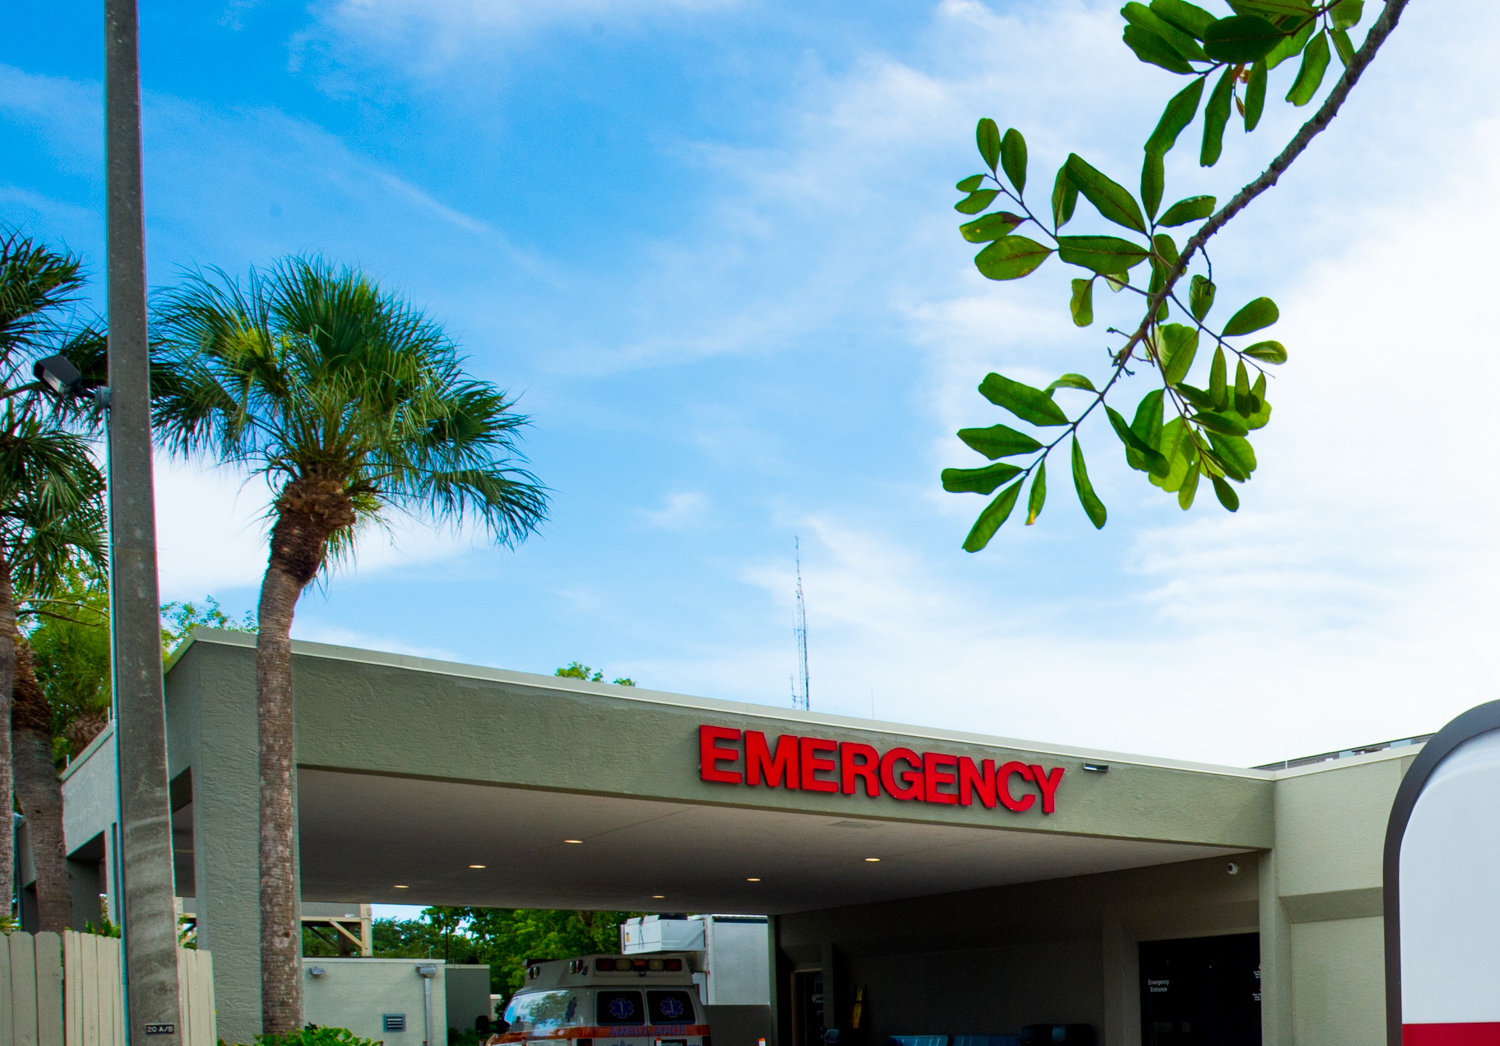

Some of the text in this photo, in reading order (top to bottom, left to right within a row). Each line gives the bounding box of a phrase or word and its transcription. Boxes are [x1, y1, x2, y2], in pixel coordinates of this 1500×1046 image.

[699, 724, 1066, 813] EMERGENCY
[1147, 979, 1170, 987] Emergency
[610, 1026, 685, 1037] AMBULANCE
